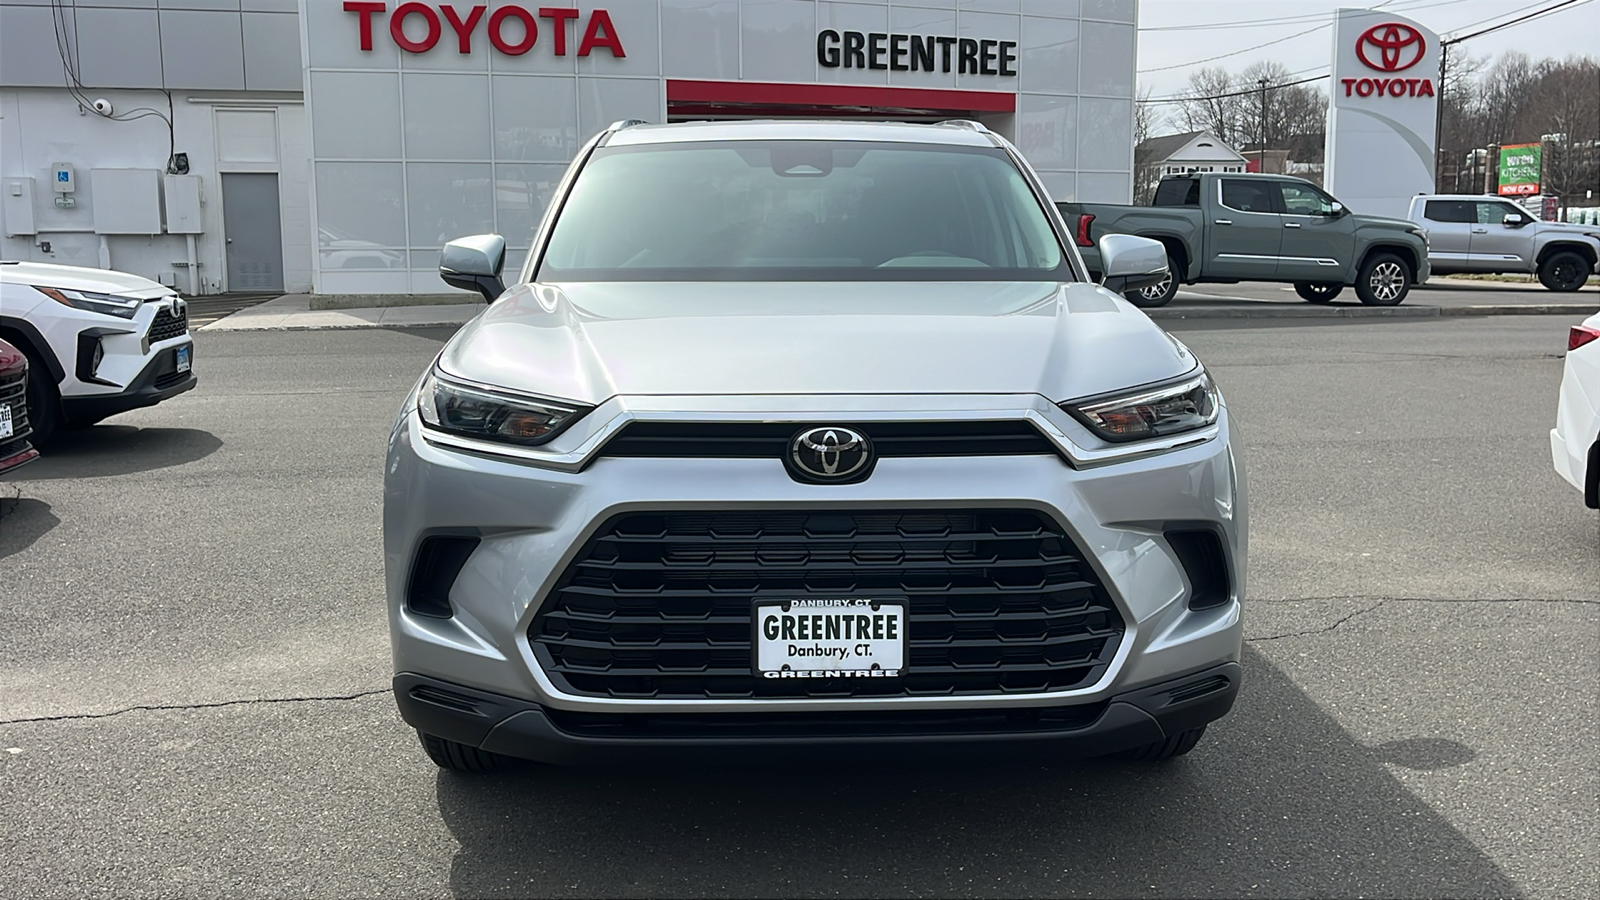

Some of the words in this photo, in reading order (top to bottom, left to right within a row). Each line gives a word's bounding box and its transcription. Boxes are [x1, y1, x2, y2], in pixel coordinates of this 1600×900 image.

[343, 1, 627, 59] TOYOTA
[817, 29, 1017, 76] GREENTREE
[1341, 78, 1435, 98] TOYOTA
[1502, 185, 1517, 194] NOW
[791, 600, 851, 608] DANBURY,
[855, 599, 872, 607] CT
[763, 614, 898, 641] GREENTREE
[788, 643, 850, 660] Danbury,
[854, 644, 873, 656] CT.
[763, 669, 899, 678] GREENTREE
